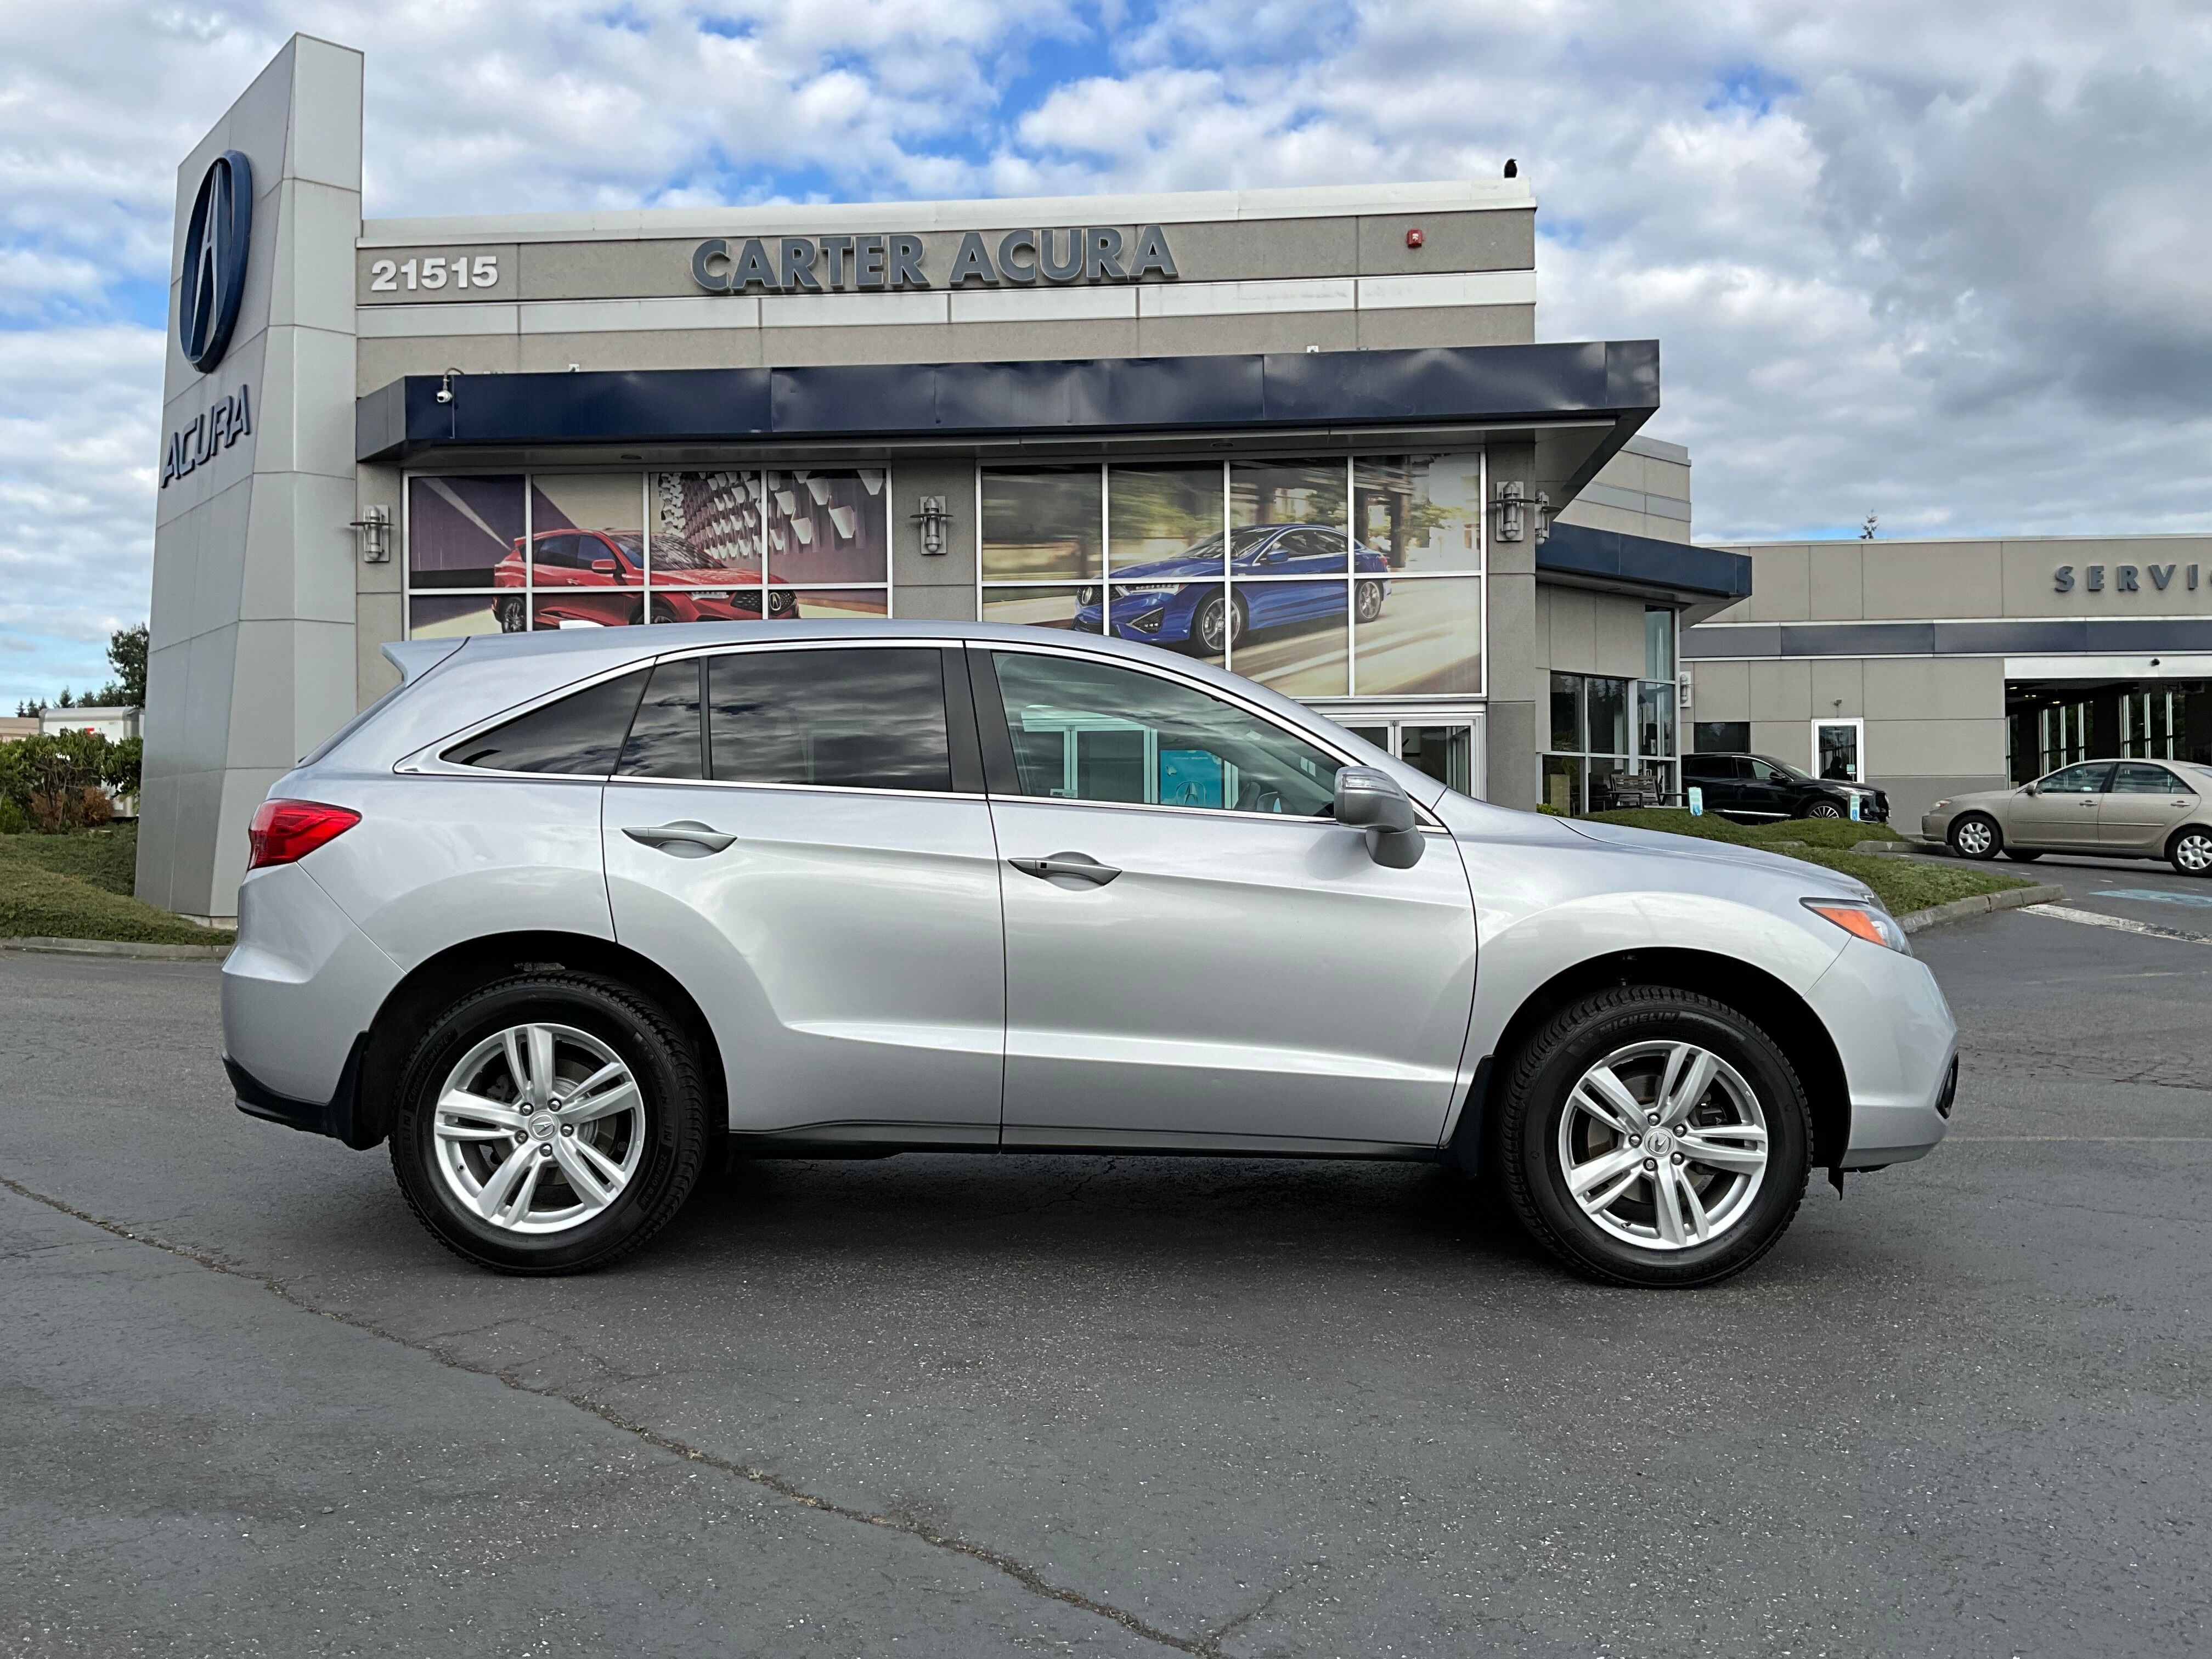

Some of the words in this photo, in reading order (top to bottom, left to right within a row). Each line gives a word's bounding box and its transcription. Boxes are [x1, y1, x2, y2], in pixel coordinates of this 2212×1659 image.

[371, 256, 499, 291] 21515
[692, 234, 930, 293] CARTER
[949, 225, 1178, 283] ACURA
[161, 385, 251, 488] ACURA
[2055, 565, 2212, 592] SERVI
[1600, 1012, 1675, 1035] MICHELIN
